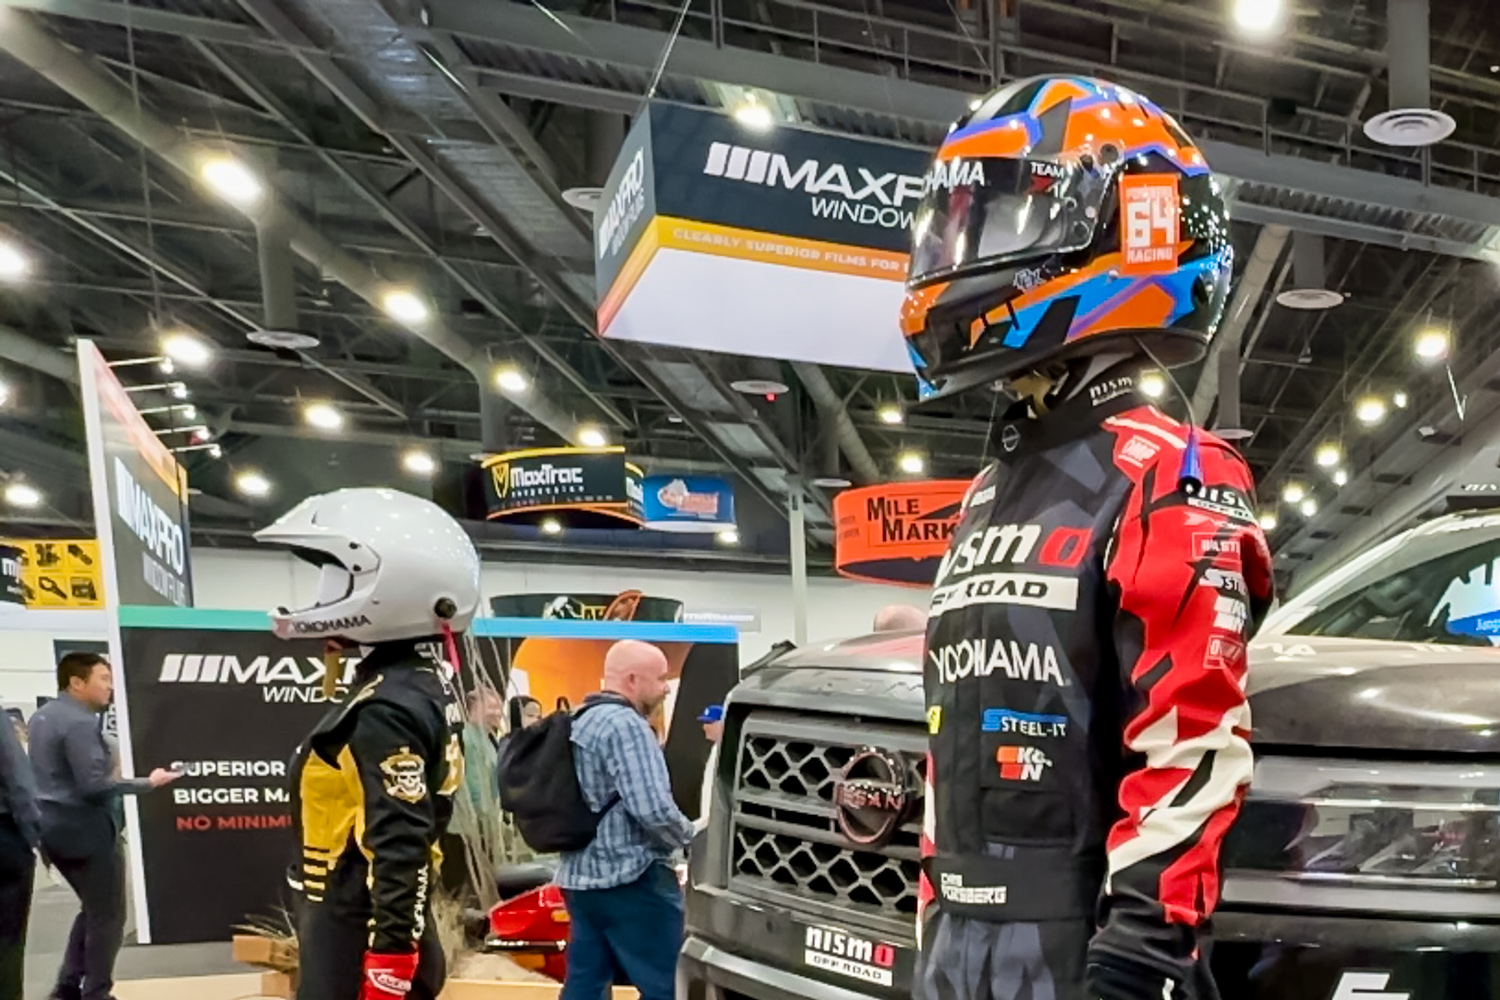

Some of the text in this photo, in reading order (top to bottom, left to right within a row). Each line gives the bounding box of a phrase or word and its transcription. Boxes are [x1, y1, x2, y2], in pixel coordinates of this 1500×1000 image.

[1030, 161, 1065, 179] TEAM
[1127, 198, 1175, 248] 64
[672, 228, 900, 272] CLEARLY SUPERIOR FILMS FOR
[1001, 715, 1067, 737] STEEL-IT
[173, 788, 258, 804] BIGGER
[176, 815, 211, 831] NO
[813, 955, 882, 980] OFF ROAD
